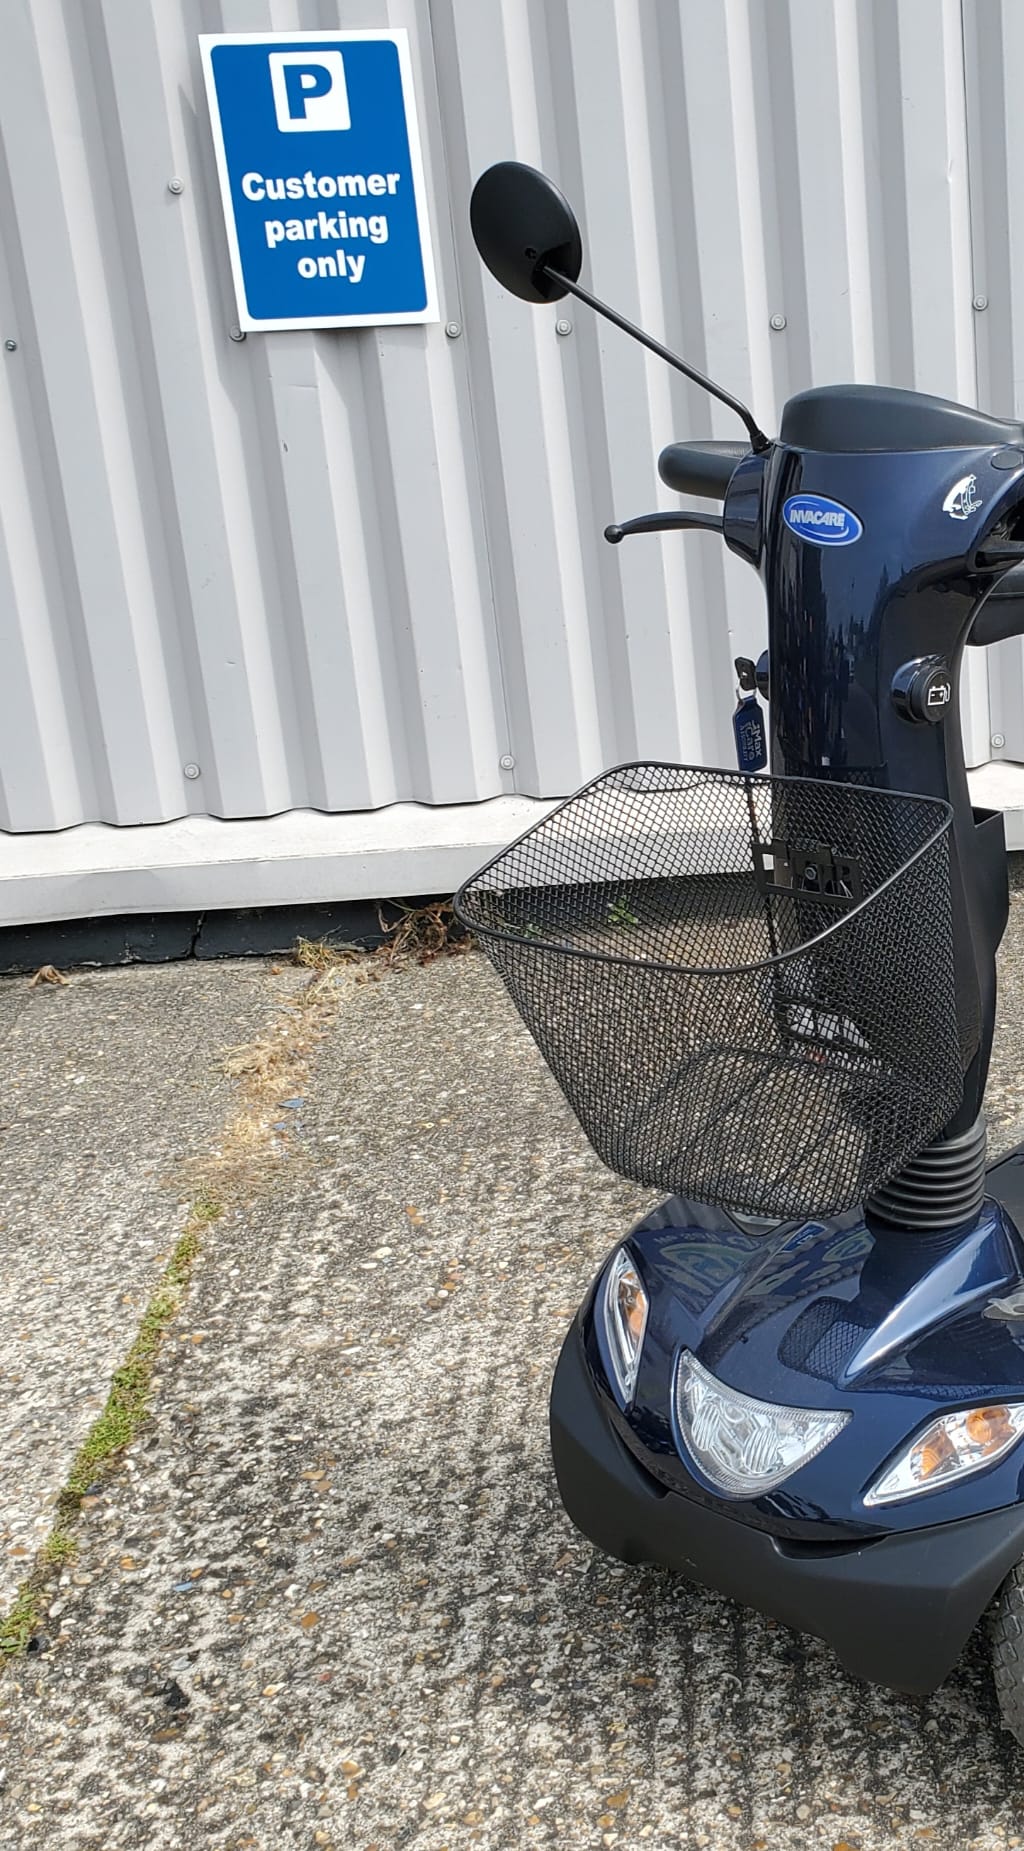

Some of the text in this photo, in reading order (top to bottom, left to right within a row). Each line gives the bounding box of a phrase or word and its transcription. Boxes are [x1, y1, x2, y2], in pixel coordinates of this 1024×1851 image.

[282, 64, 332, 120] P
[241, 170, 400, 202] Customer
[264, 210, 389, 249] parking
[297, 249, 366, 283] only
[789, 508, 846, 528] INVACARE
